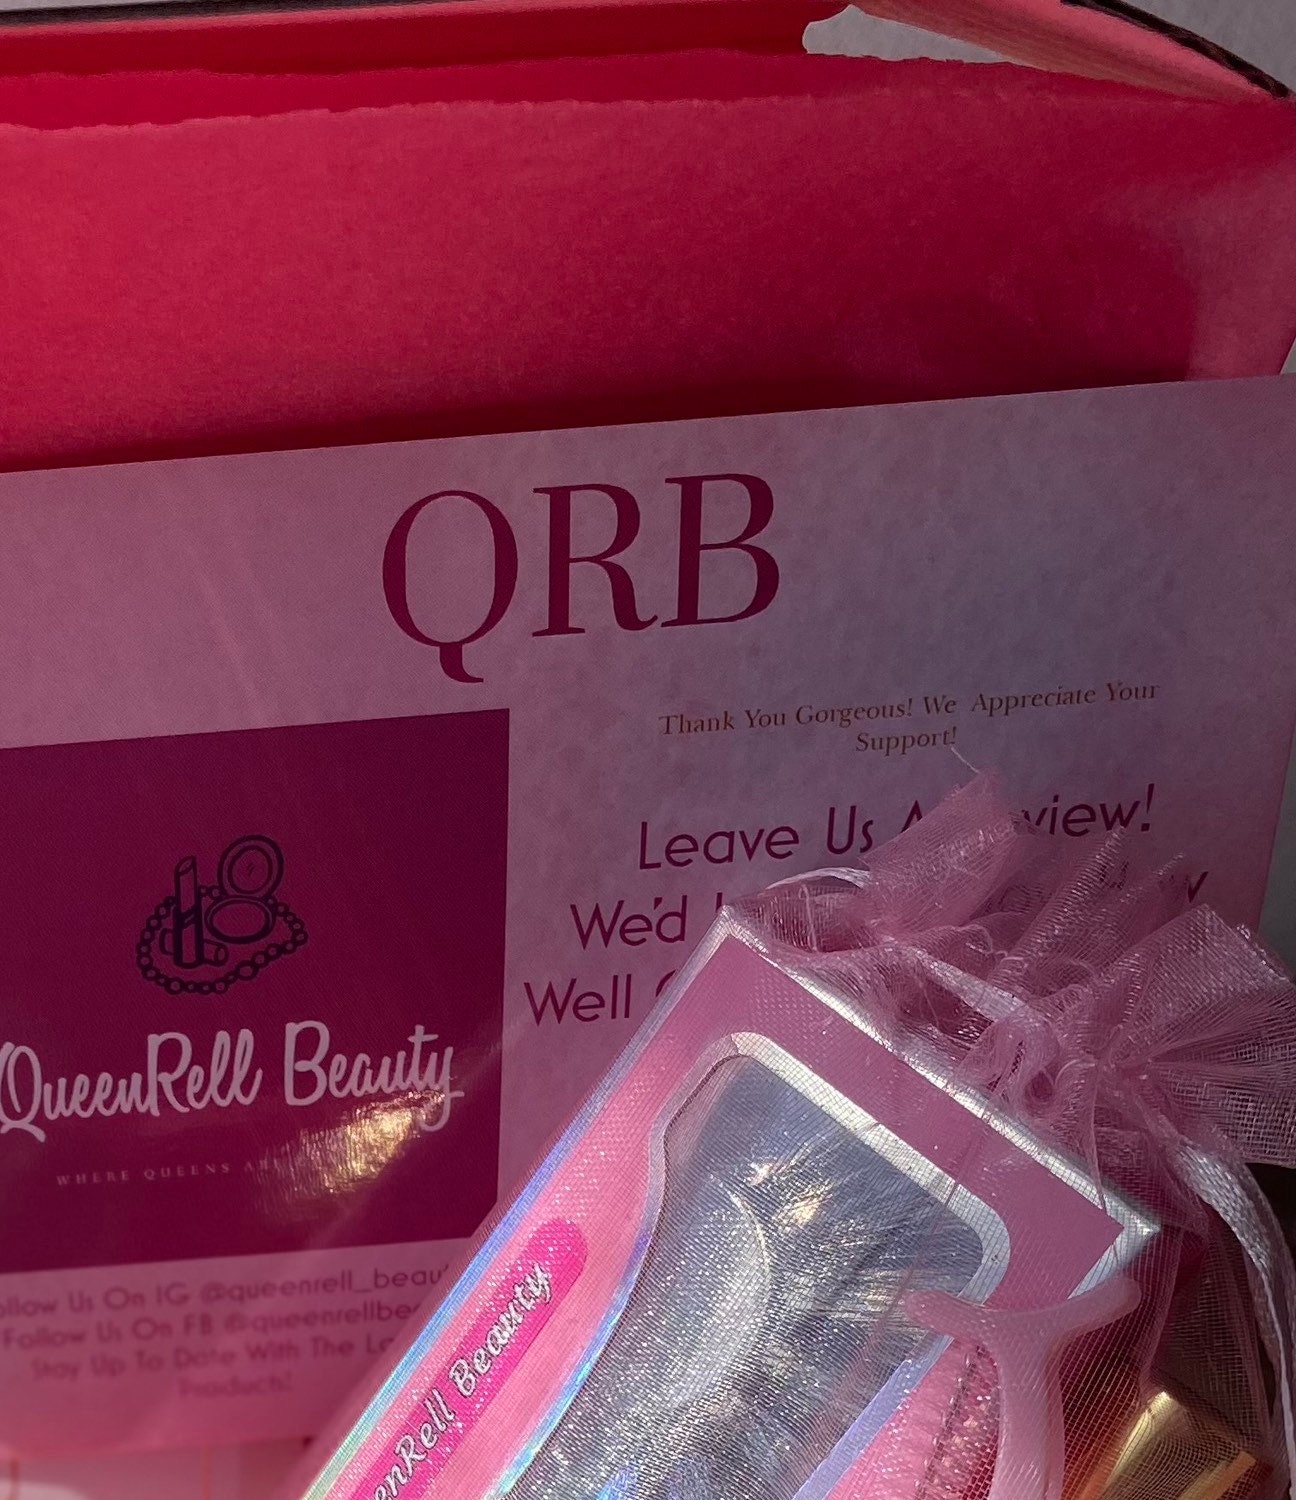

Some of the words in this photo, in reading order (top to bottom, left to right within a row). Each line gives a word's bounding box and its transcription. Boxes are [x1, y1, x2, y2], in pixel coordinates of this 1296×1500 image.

[381, 472, 780, 684] QRB
[658, 709, 736, 736] Thank
[744, 707, 787, 730] You
[794, 697, 914, 729] Gorgeous!
[921, 695, 958, 716] We
[970, 684, 1097, 716] Appreciate
[1106, 680, 1162, 703] Your
[854, 725, 958, 755] Support!
[638, 820, 801, 870] Leave
[824, 805, 874, 855] Us
[570, 894, 688, 951] We'd
[524, 973, 632, 1027] Well
[283, 1019, 465, 1132] Beauty
[55, 1169, 130, 1186] WHERE
[143, 1162, 231, 1181] QUEENS
[67, 1288, 95, 1314] Us
[102, 1285, 146, 1310] On
[155, 1281, 191, 1306] IG
[199, 1264, 449, 1304] @queenrell_beau
[1, 1326, 87, 1351] Follow
[95, 1319, 123, 1344] Us
[130, 1315, 174, 1341] On
[183, 1311, 214, 1337] FB
[134, 1348, 165, 1372] To
[244, 1338, 302, 1362] With
[310, 1333, 354, 1357] The
[448, 1262, 553, 1400] Beauty
